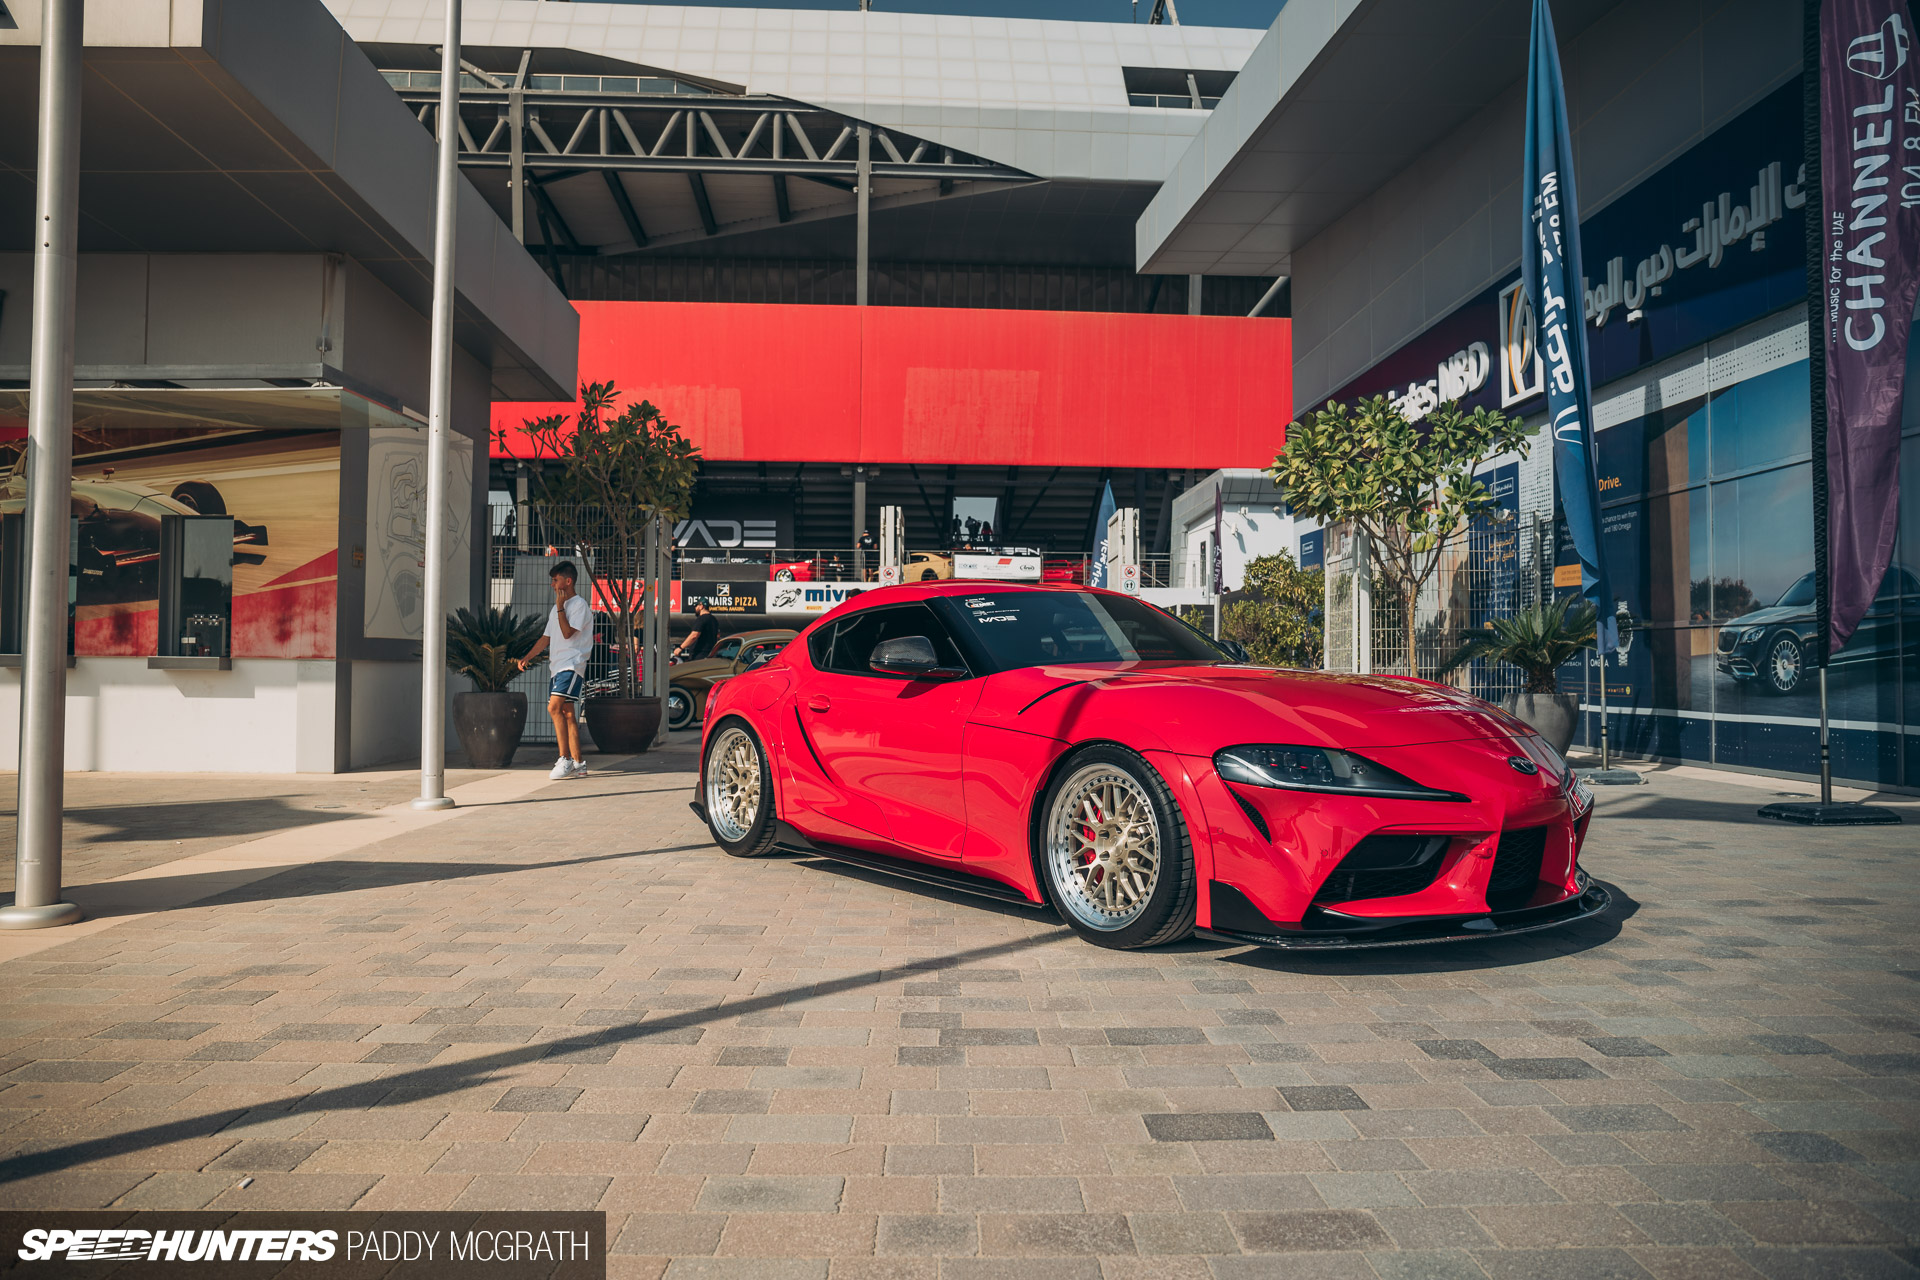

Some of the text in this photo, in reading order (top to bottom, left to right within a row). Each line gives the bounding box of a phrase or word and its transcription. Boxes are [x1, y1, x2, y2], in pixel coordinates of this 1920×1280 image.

[1541, 171, 1558, 211] FM
[1832, 211, 1845, 236] UAE
[1844, 84, 1894, 351] CHANNEL
[1830, 239, 1843, 262] the
[1829, 266, 1842, 283] for
[1438, 341, 1489, 408] NBD
[1599, 476, 1622, 491] Drive.
[688, 596, 757, 606] DENAIRS PIZZA
[805, 585, 868, 602] miv
[1590, 659, 1609, 667] OMEA
